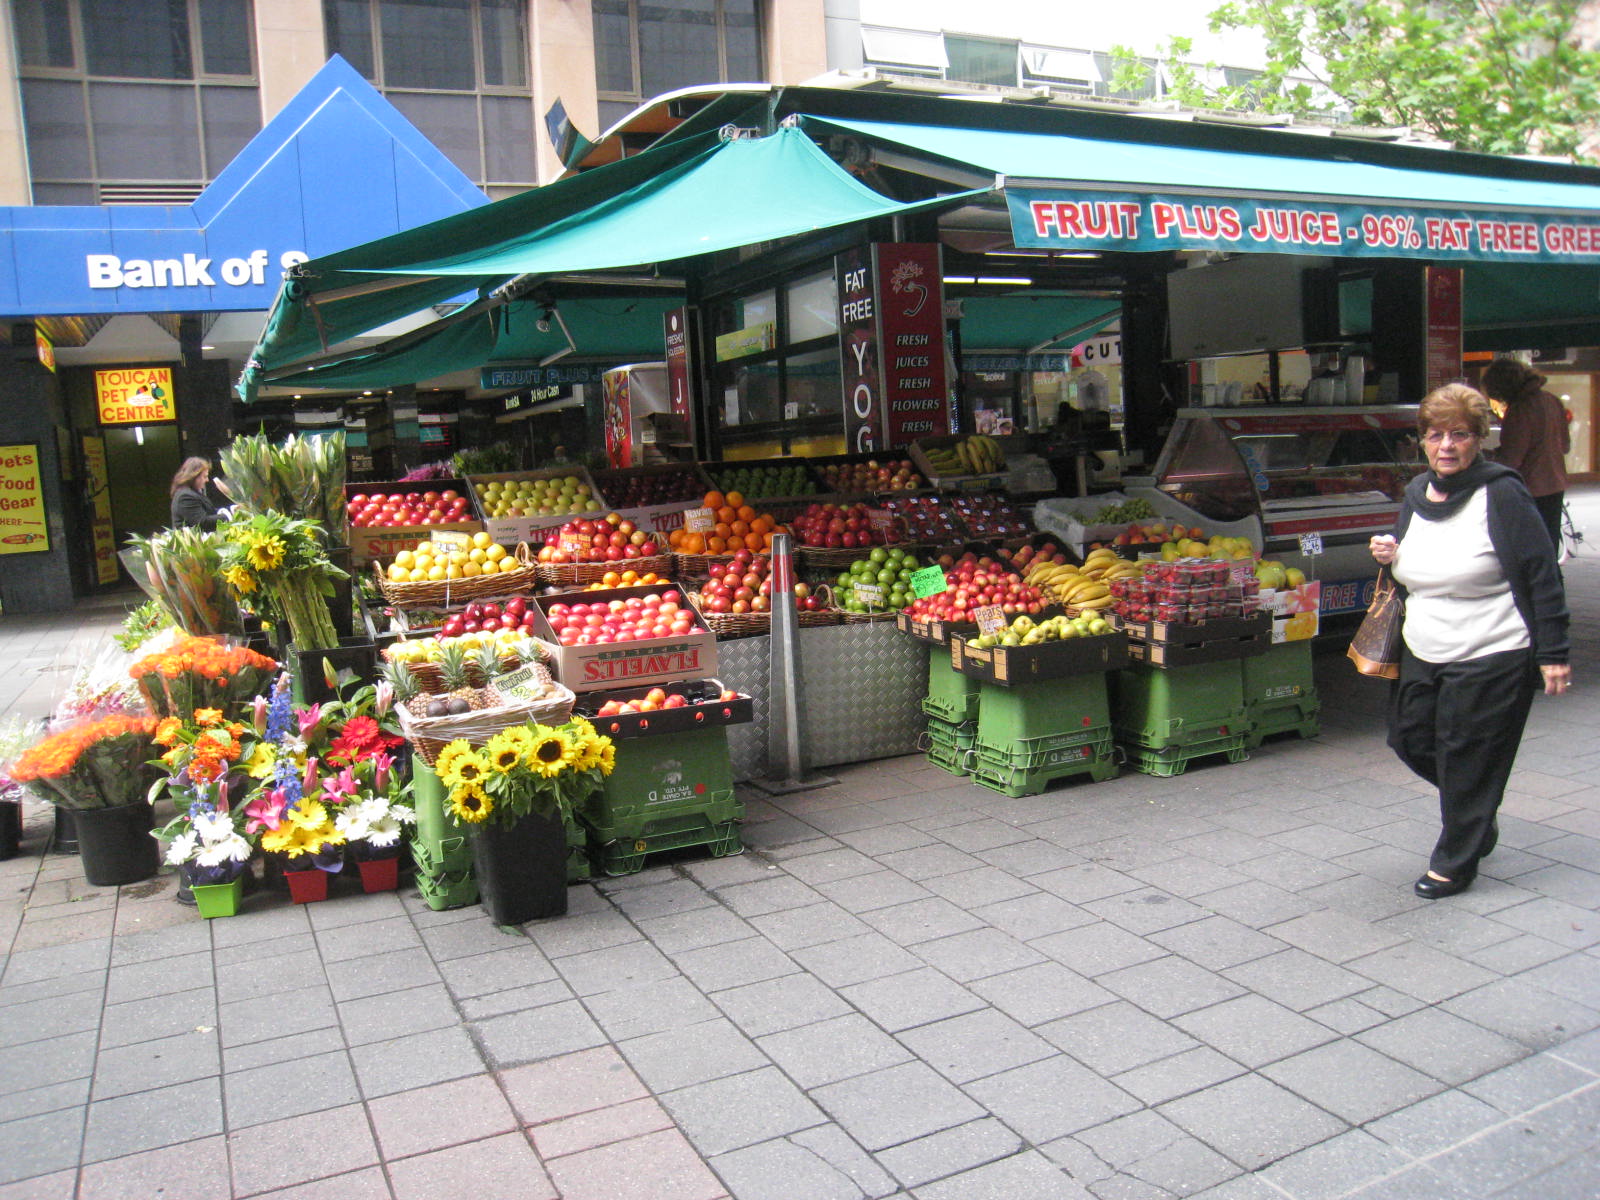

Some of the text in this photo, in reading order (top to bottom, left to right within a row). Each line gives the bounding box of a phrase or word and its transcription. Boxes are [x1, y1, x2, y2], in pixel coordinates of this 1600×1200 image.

[1031, 201, 1141, 241] FRUIT
[1152, 202, 1241, 239] PLUS
[1249, 208, 1341, 246] JUICE
[1363, 215, 1421, 250] 96%
[1425, 217, 1473, 251] FAT
[1478, 220, 1540, 253] FREE
[86, 253, 216, 289] Bank
[221, 249, 268, 286] of
[845, 268, 866, 293] FAT
[843, 297, 873, 324] FREE
[896, 334, 929, 346] FRESH
[896, 356, 929, 369] JUICES
[97, 370, 169, 386] TOUCAN
[492, 369, 542, 386] FRUIT
[547, 367, 590, 383] PLUS
[899, 378, 931, 389] FRESH
[101, 388, 129, 403] PET
[102, 405, 165, 421] CENTRE
[892, 399, 941, 412] FLOWERS
[902, 421, 933, 433] FRESH
[1321, 582, 1358, 611] FREE
[584, 649, 700, 682] FLAVELL'S
